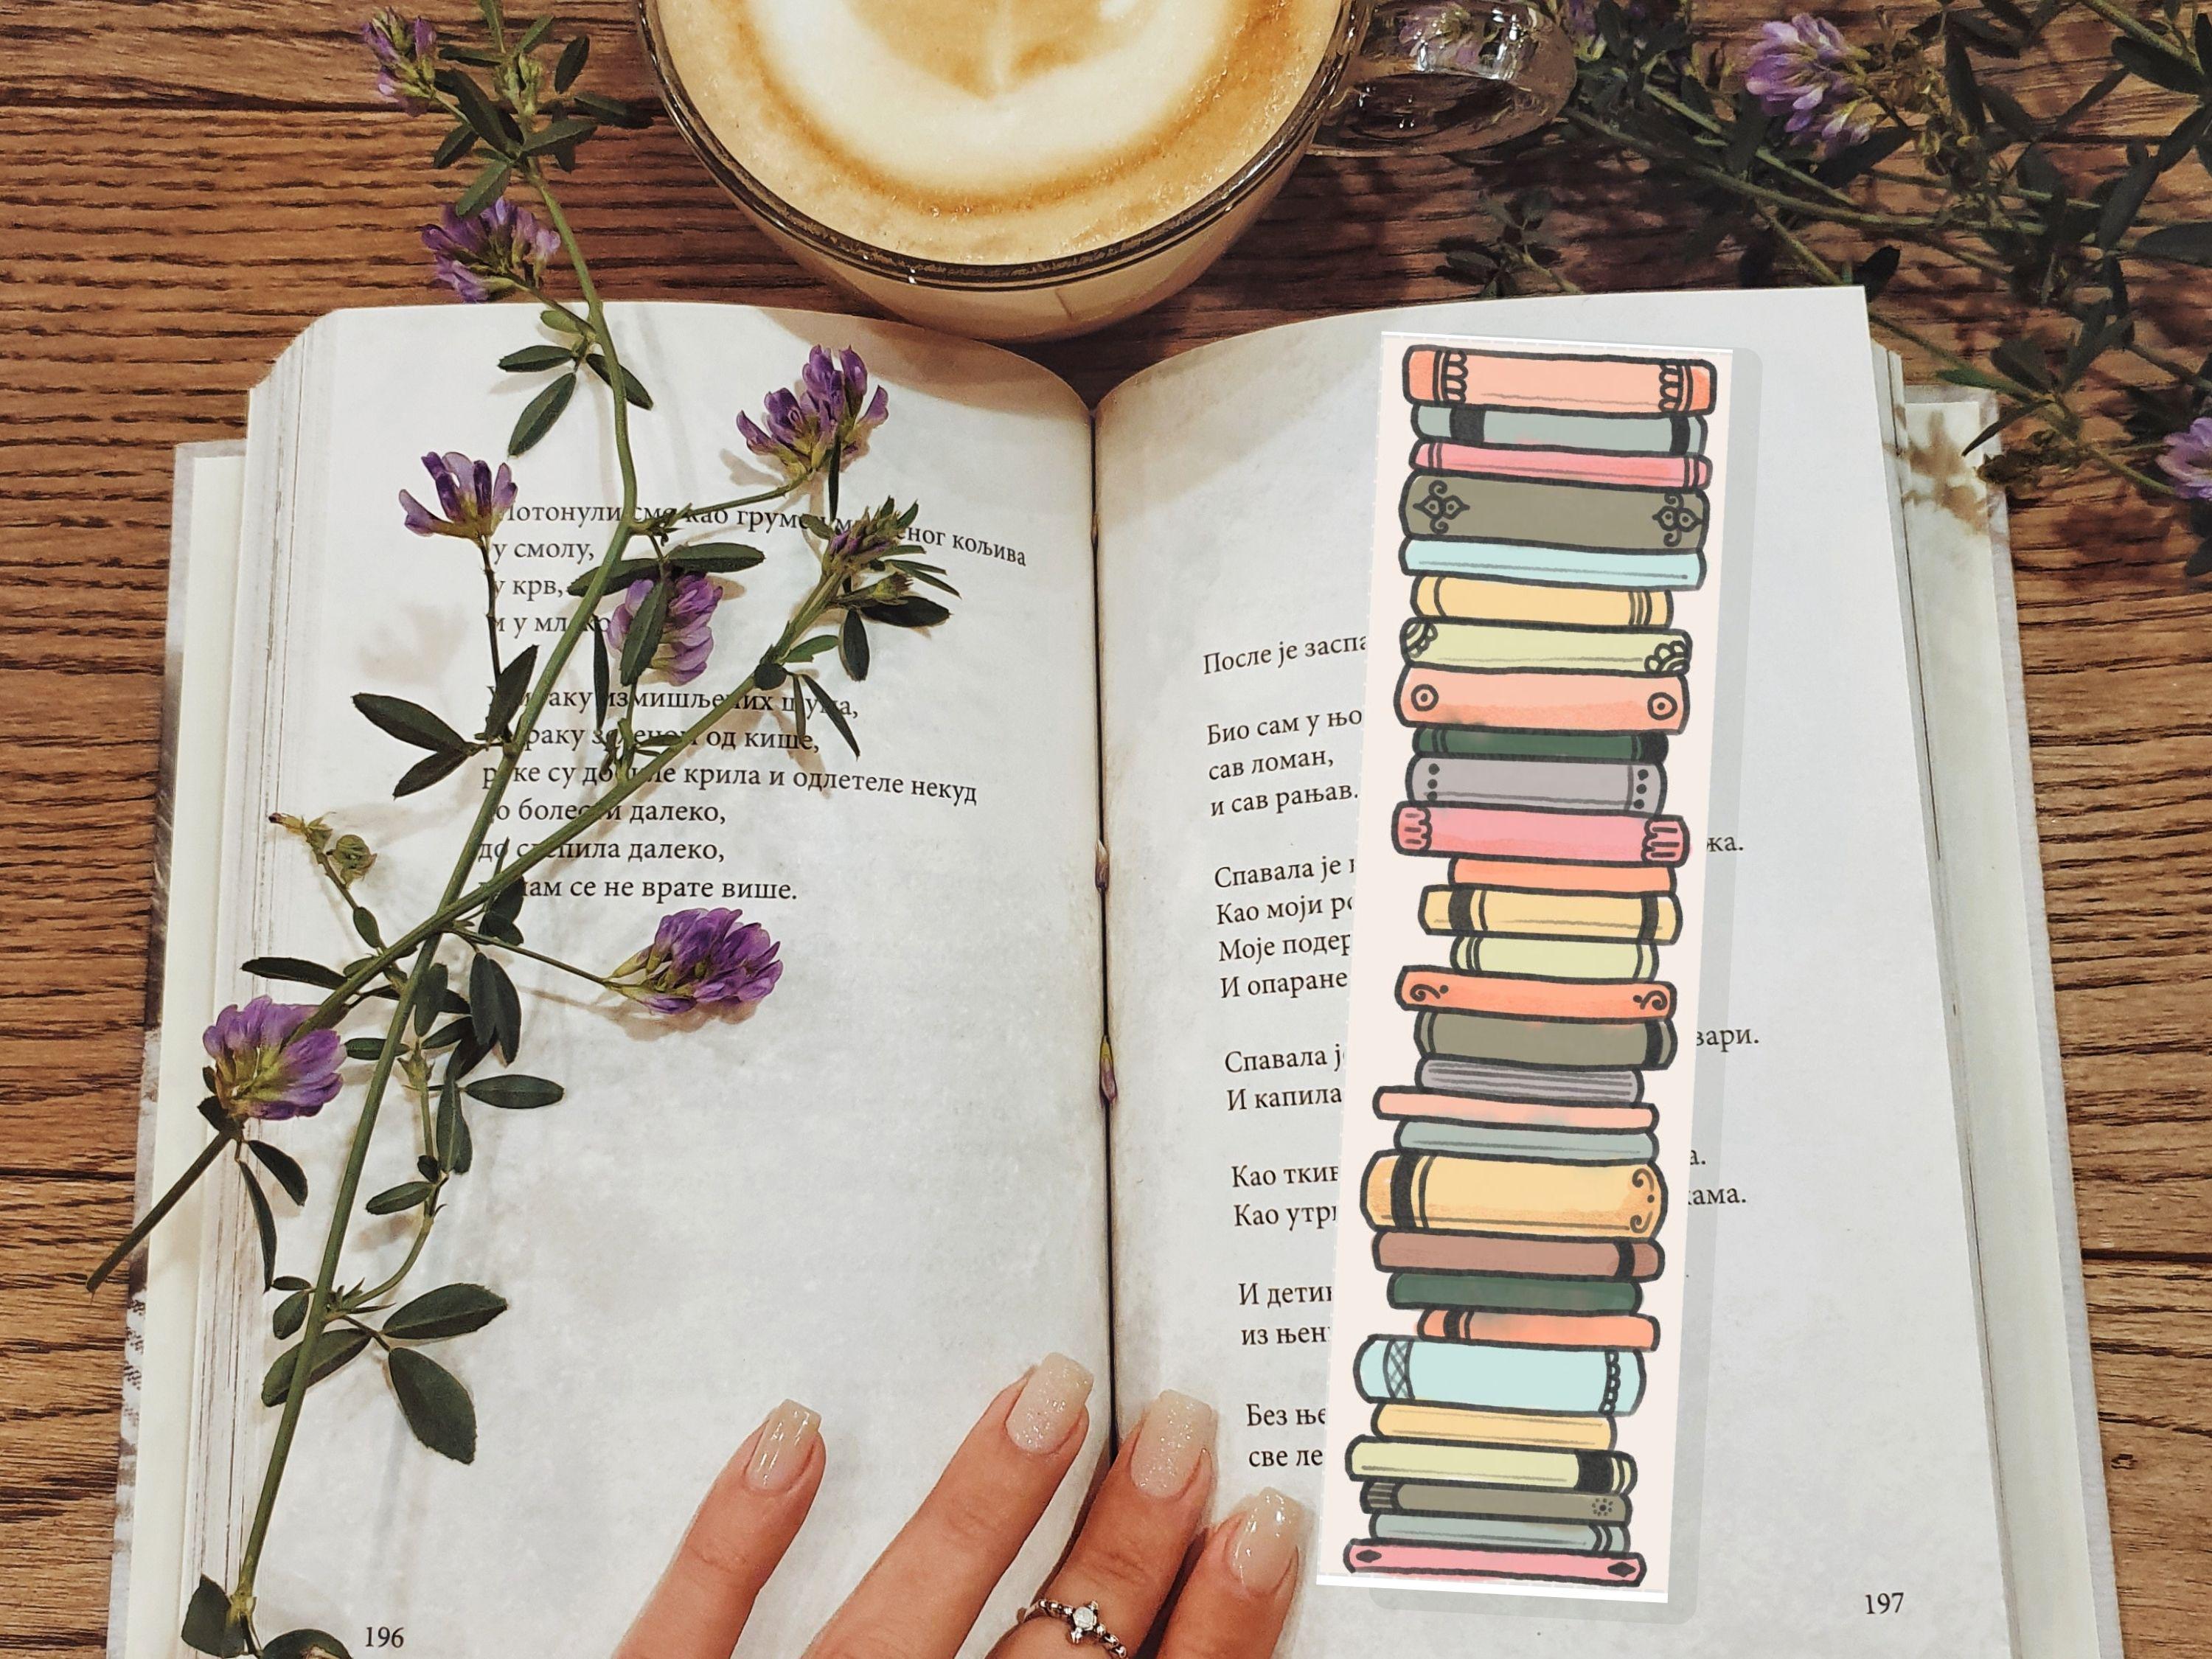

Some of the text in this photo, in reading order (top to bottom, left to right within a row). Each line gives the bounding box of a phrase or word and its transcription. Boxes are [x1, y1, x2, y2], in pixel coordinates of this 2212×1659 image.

[492, 541, 594, 566] у смолу,
[952, 534, 1026, 567] кољива
[512, 580, 563, 602] крв,
[512, 617, 528, 639] у
[1203, 649, 1272, 675] После
[1277, 641, 1298, 669] је
[706, 729, 737, 751] од
[743, 730, 821, 754] кише,
[1206, 723, 1250, 745] Био
[1256, 717, 1300, 737] сам
[1305, 714, 1321, 737] у
[1208, 750, 1334, 781] сав ломан,
[481, 765, 977, 807] рке су доле крила и одлетеле некуд
[1210, 784, 1358, 817] и сав рањав.
[629, 804, 726, 825] далеко,
[516, 842, 621, 858] спила
[627, 843, 725, 863] далеко,
[1214, 863, 1315, 888] Спавала
[1320, 855, 1342, 884] је
[570, 880, 597, 897] се
[603, 881, 634, 897] не
[641, 881, 714, 905] врате
[721, 883, 797, 900] више.
[1216, 902, 1259, 925] Као
[1266, 894, 1324, 923] моји
[1218, 936, 1276, 965] Моје
[1220, 972, 1348, 999] И опаране
[1225, 1050, 1328, 1074] Спавала
[1226, 1085, 1342, 1111] И капила
[1231, 1164, 1277, 1188] Као
[1233, 1203, 1279, 1227] Као
[1688, 1187, 1747, 1206] ама.
[1238, 1282, 1260, 1306] И
[1241, 1326, 1330, 1346] из њен
[1245, 1403, 1288, 1427] Без
[1248, 1449, 1324, 1468] све ле
[1865, 1592, 1905, 1615] 197
[365, 1626, 405, 1649] 196
